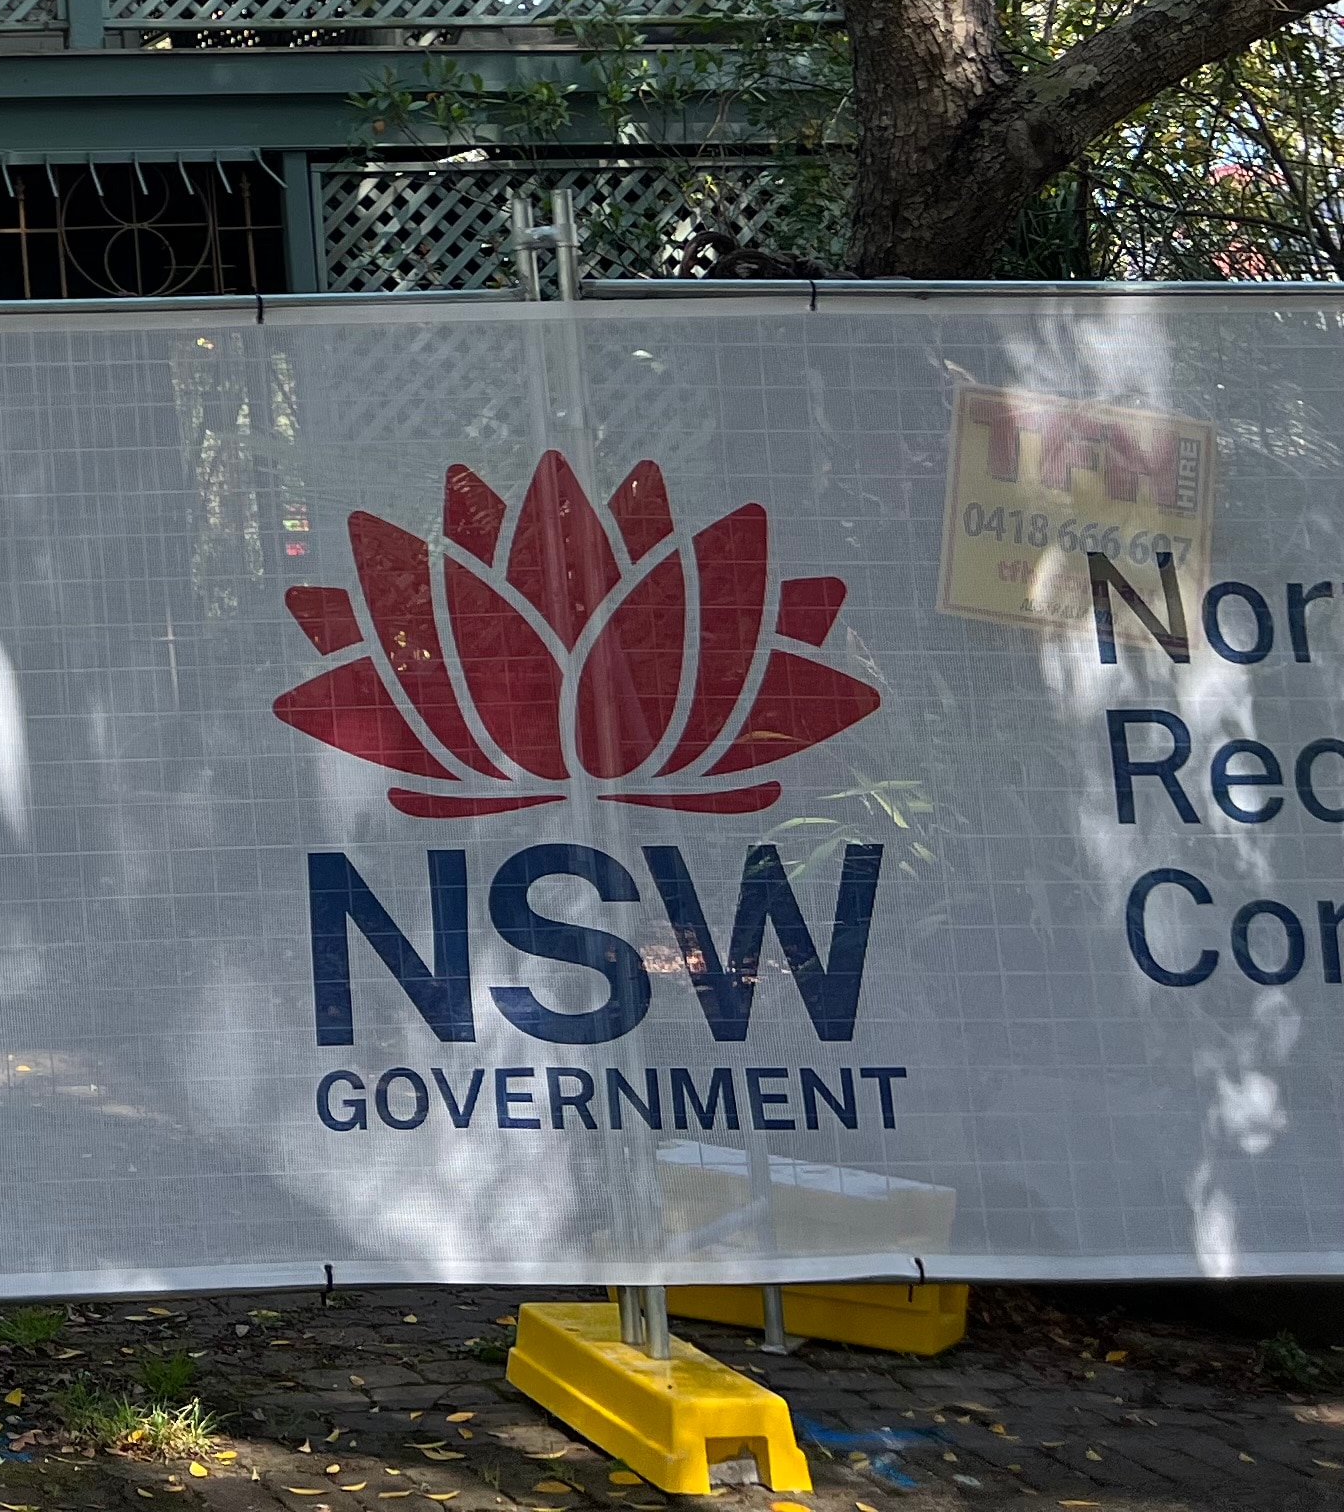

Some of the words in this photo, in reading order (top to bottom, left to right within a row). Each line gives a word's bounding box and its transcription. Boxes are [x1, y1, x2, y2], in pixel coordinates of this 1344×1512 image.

[1176, 438, 1201, 509] HIRE
[962, 501, 1050, 548] 0418
[1057, 518, 1122, 562] 666
[1087, 551, 1344, 665] Nor
[1105, 708, 1344, 825] Rec
[306, 843, 885, 1047] NSW
[315, 1065, 907, 1132] GOVERNMENT
